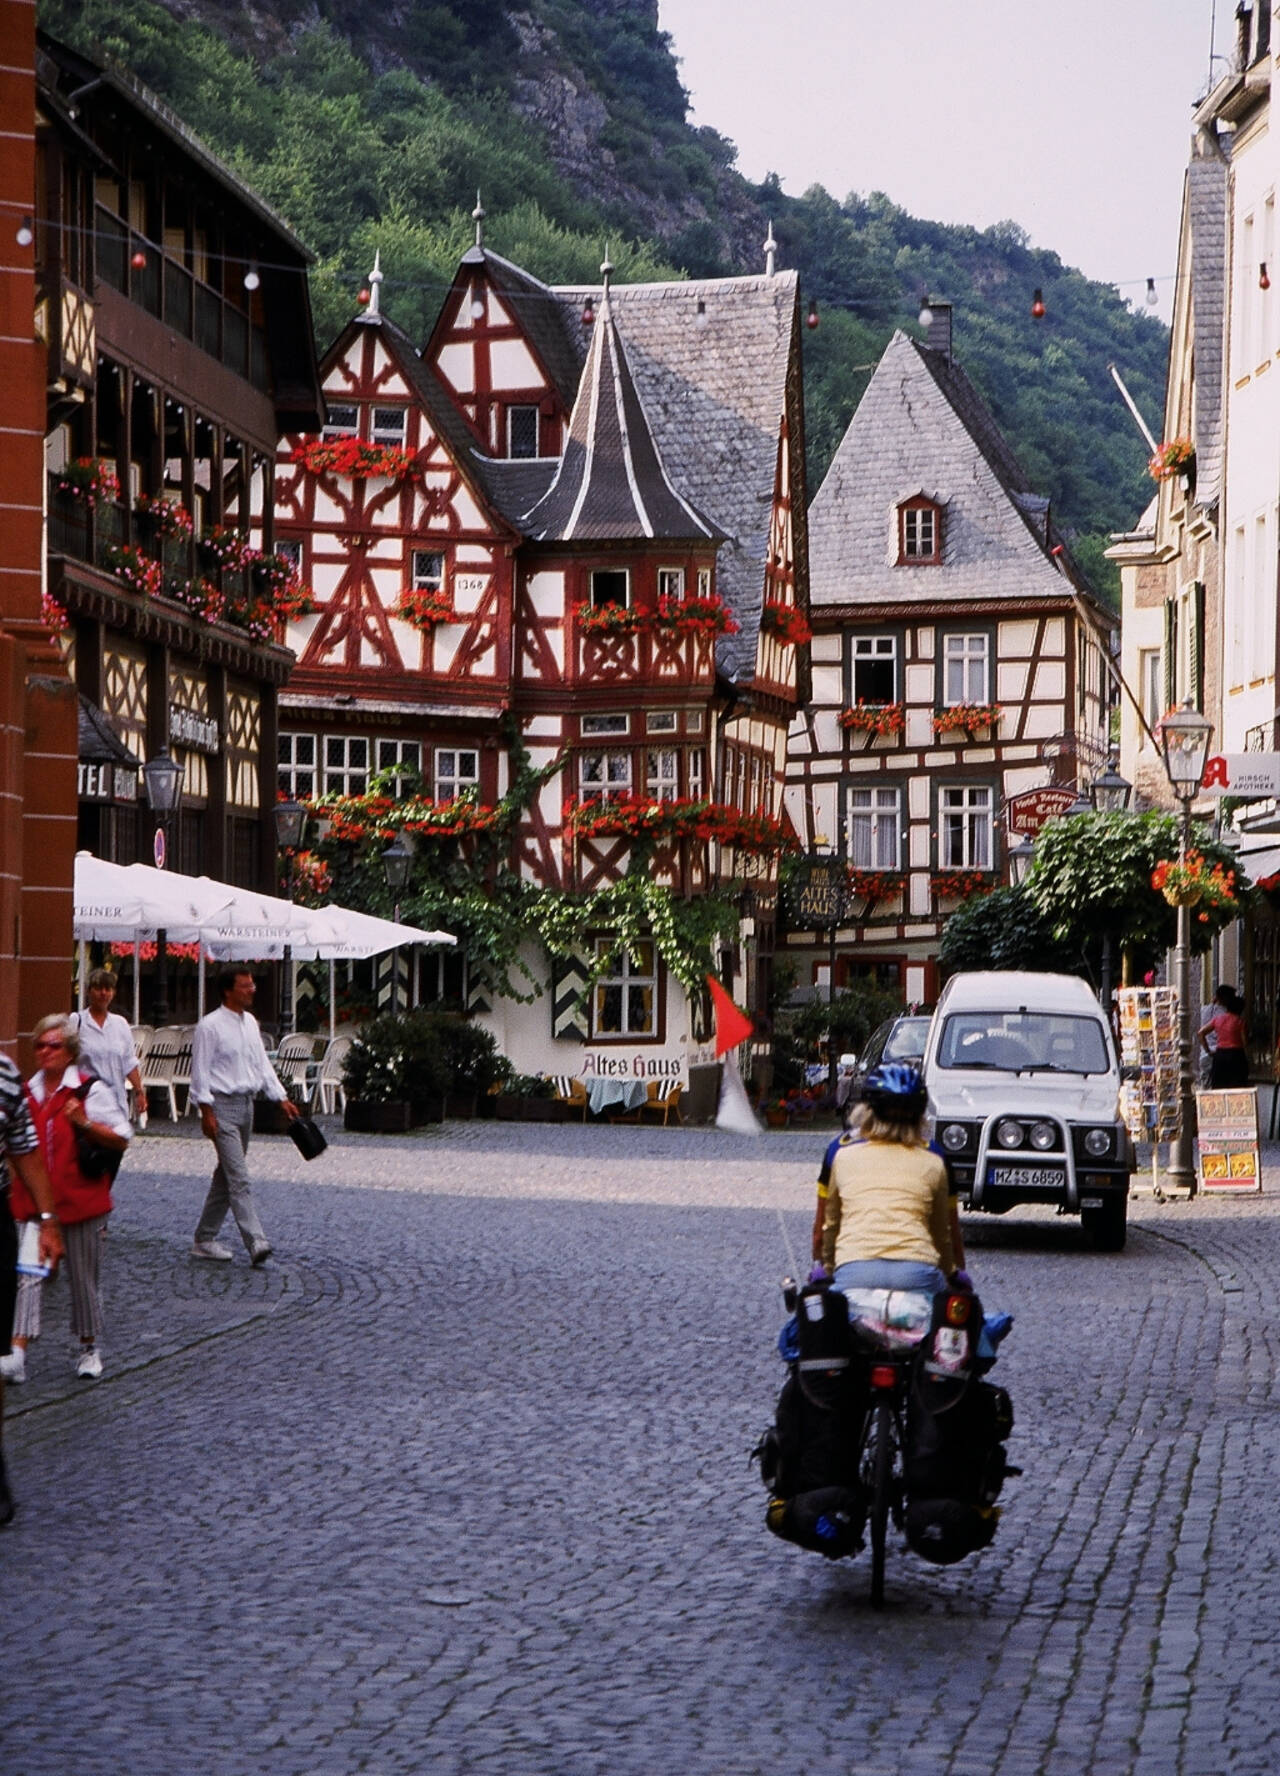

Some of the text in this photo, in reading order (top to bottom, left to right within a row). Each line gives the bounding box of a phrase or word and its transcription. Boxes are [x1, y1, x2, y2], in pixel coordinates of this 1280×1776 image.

[1238, 774, 1270, 782] HIRSCH
[1233, 782, 1275, 790] APOTHEKE
[800, 887, 838, 900] ALTES
[800, 900, 837, 914] HAUS
[217, 927, 292, 938] WARSTEINER
[1031, 1169, 1064, 1185] 6859
